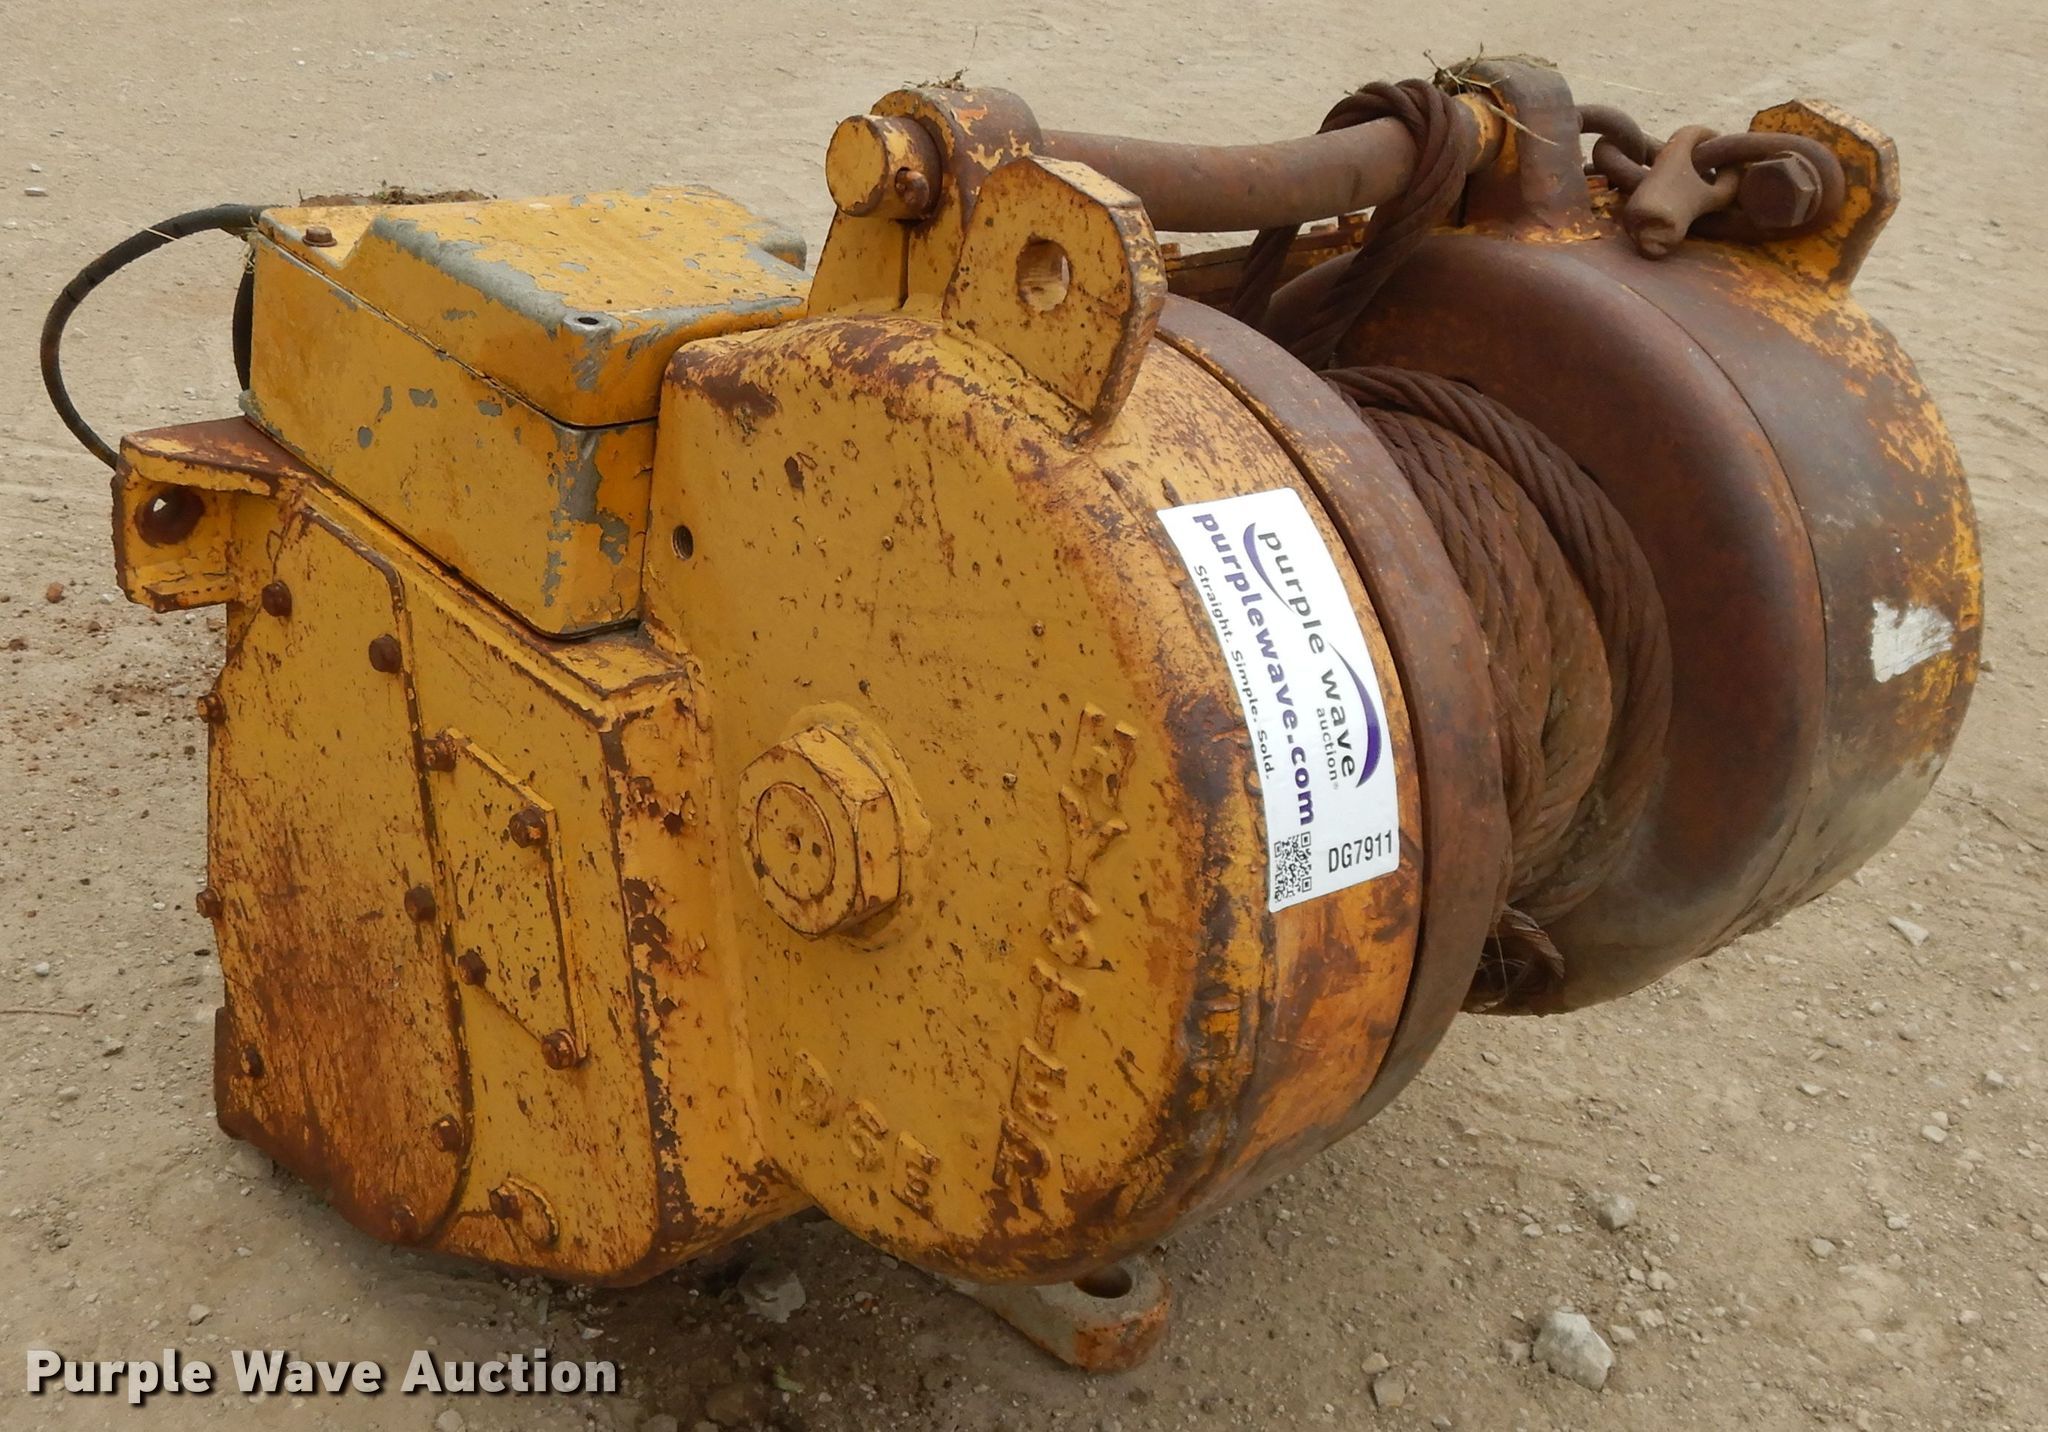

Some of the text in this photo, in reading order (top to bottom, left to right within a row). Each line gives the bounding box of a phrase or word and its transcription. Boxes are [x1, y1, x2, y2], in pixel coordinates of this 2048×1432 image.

[1192, 513, 1315, 826] purplewave.com
[1194, 565, 1276, 780] Straight. Simple. Sold.
[1257, 532, 1356, 777] purple wave
[1328, 829, 1393, 873] DG7911
